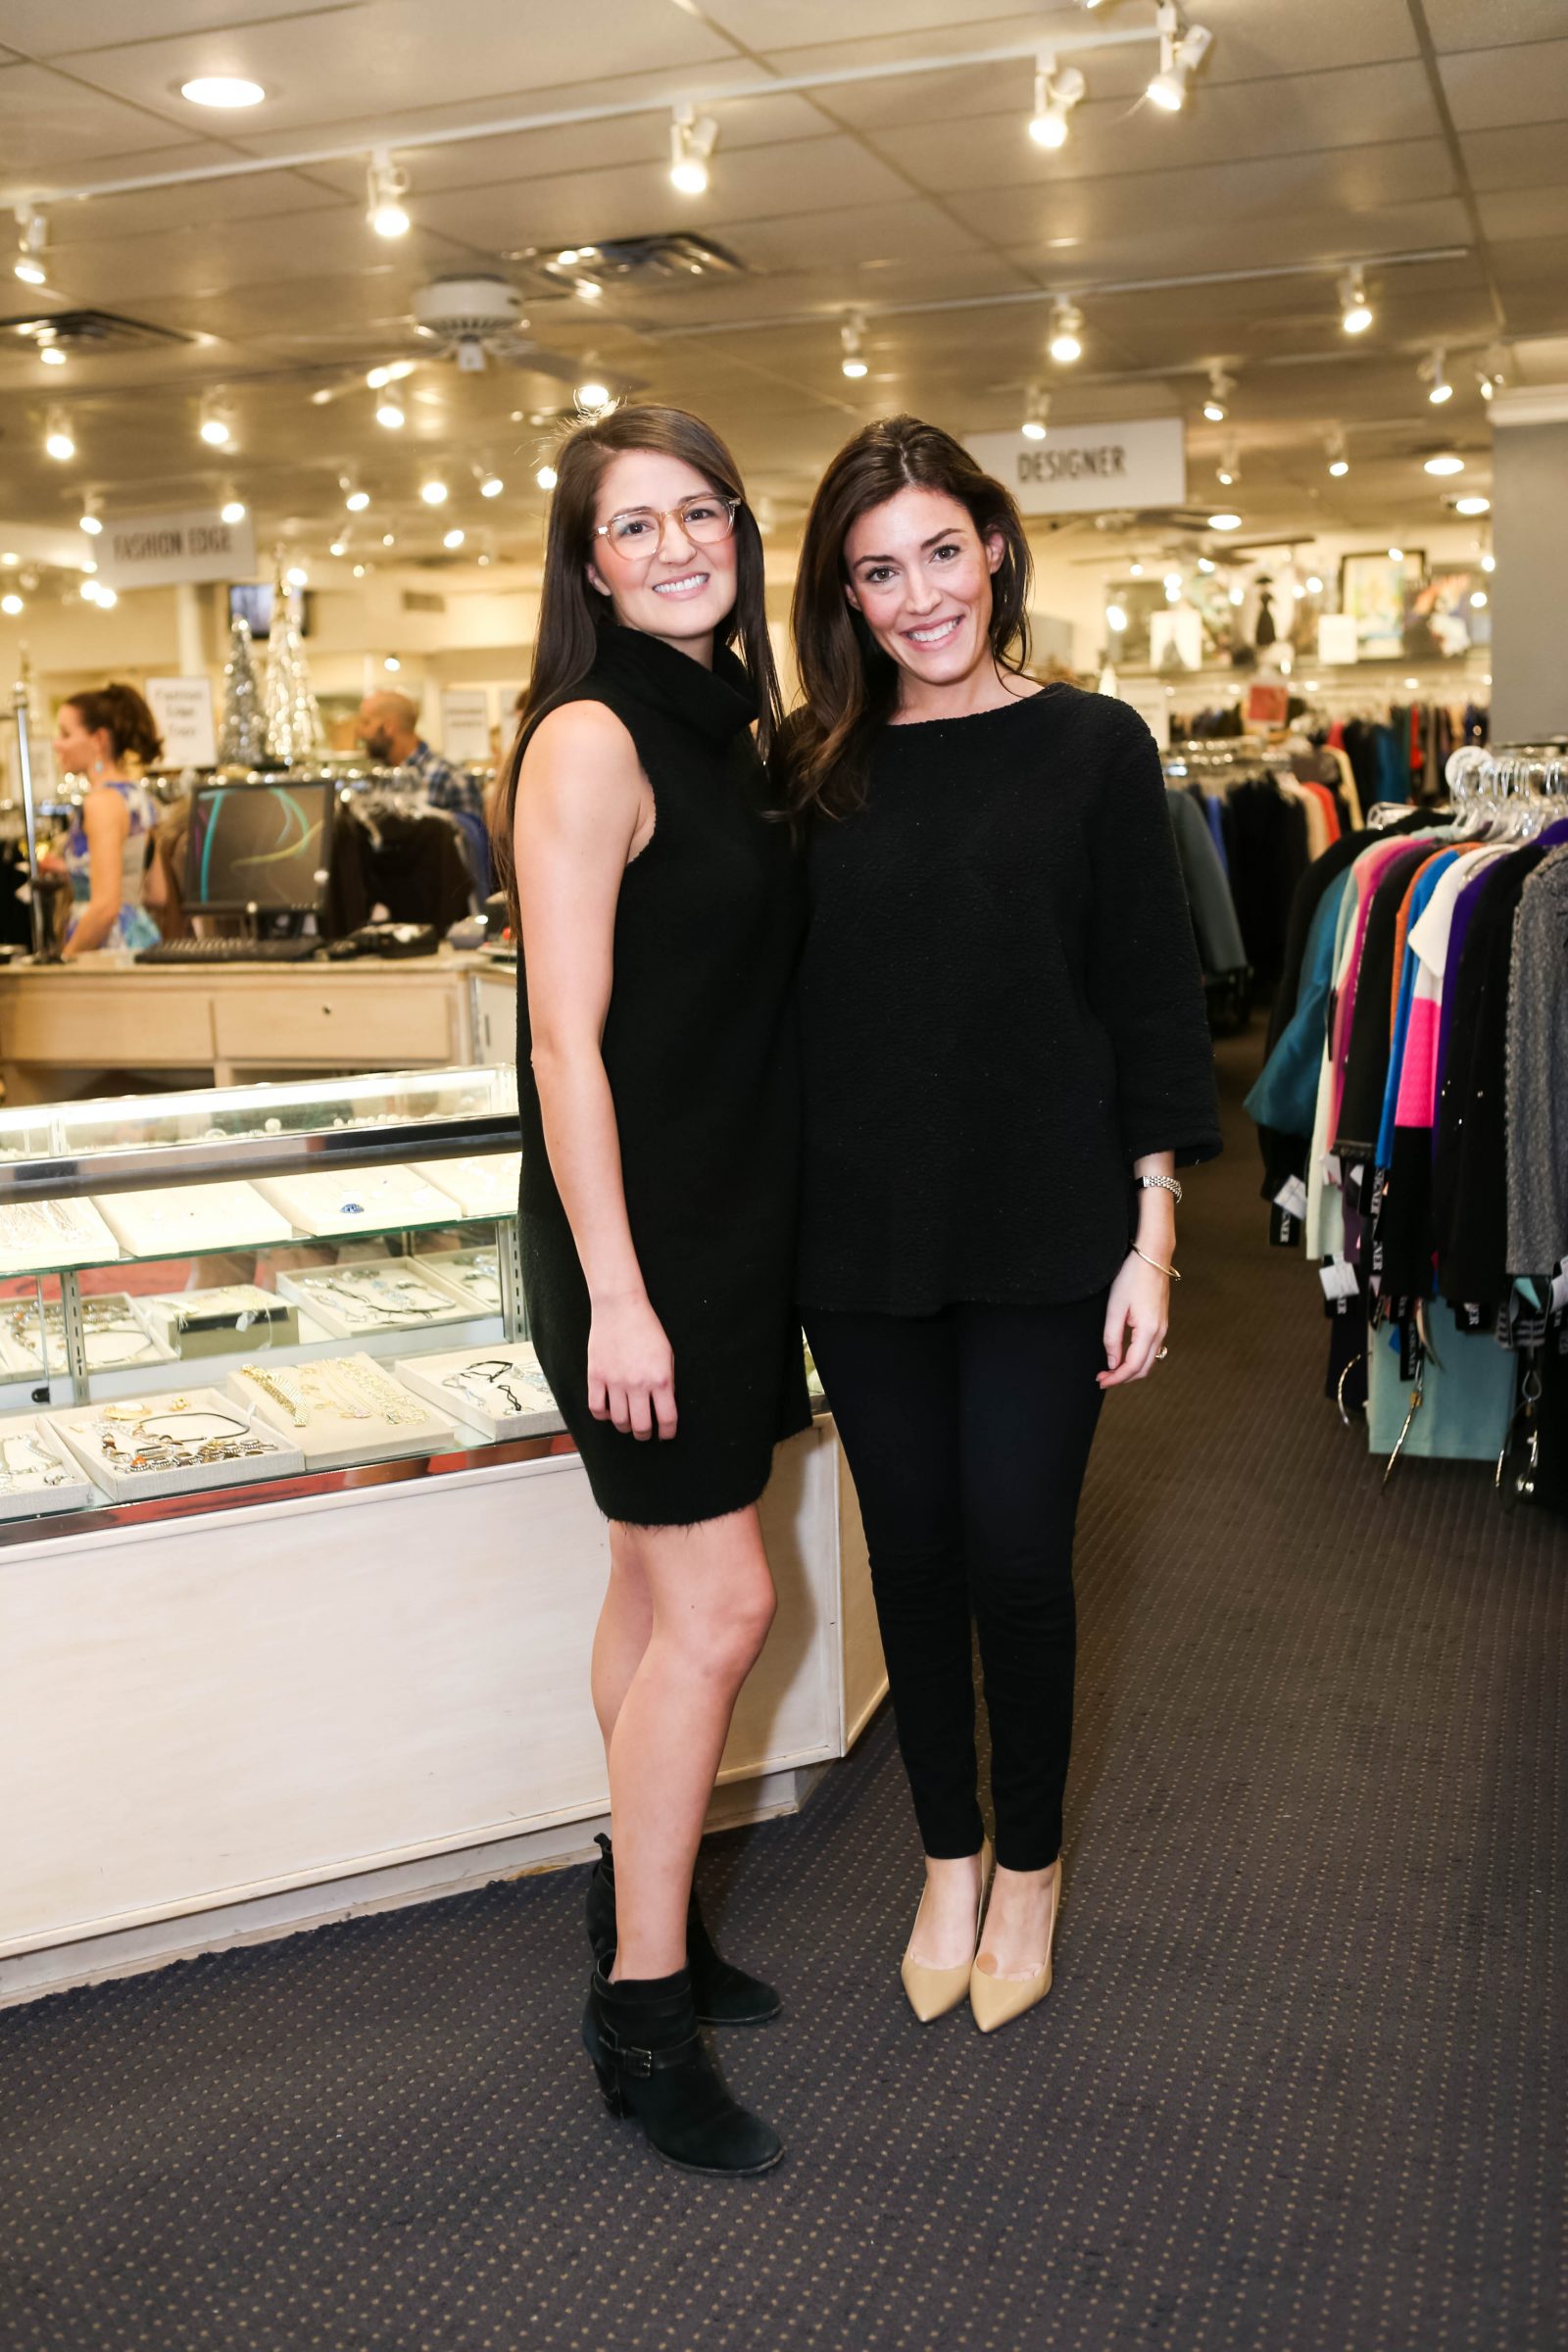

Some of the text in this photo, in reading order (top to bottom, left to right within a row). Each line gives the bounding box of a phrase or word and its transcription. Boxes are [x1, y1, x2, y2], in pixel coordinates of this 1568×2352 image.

[1017, 445, 1127, 483] DESIGNER
[113, 525, 231, 562] FASHION EDGE
